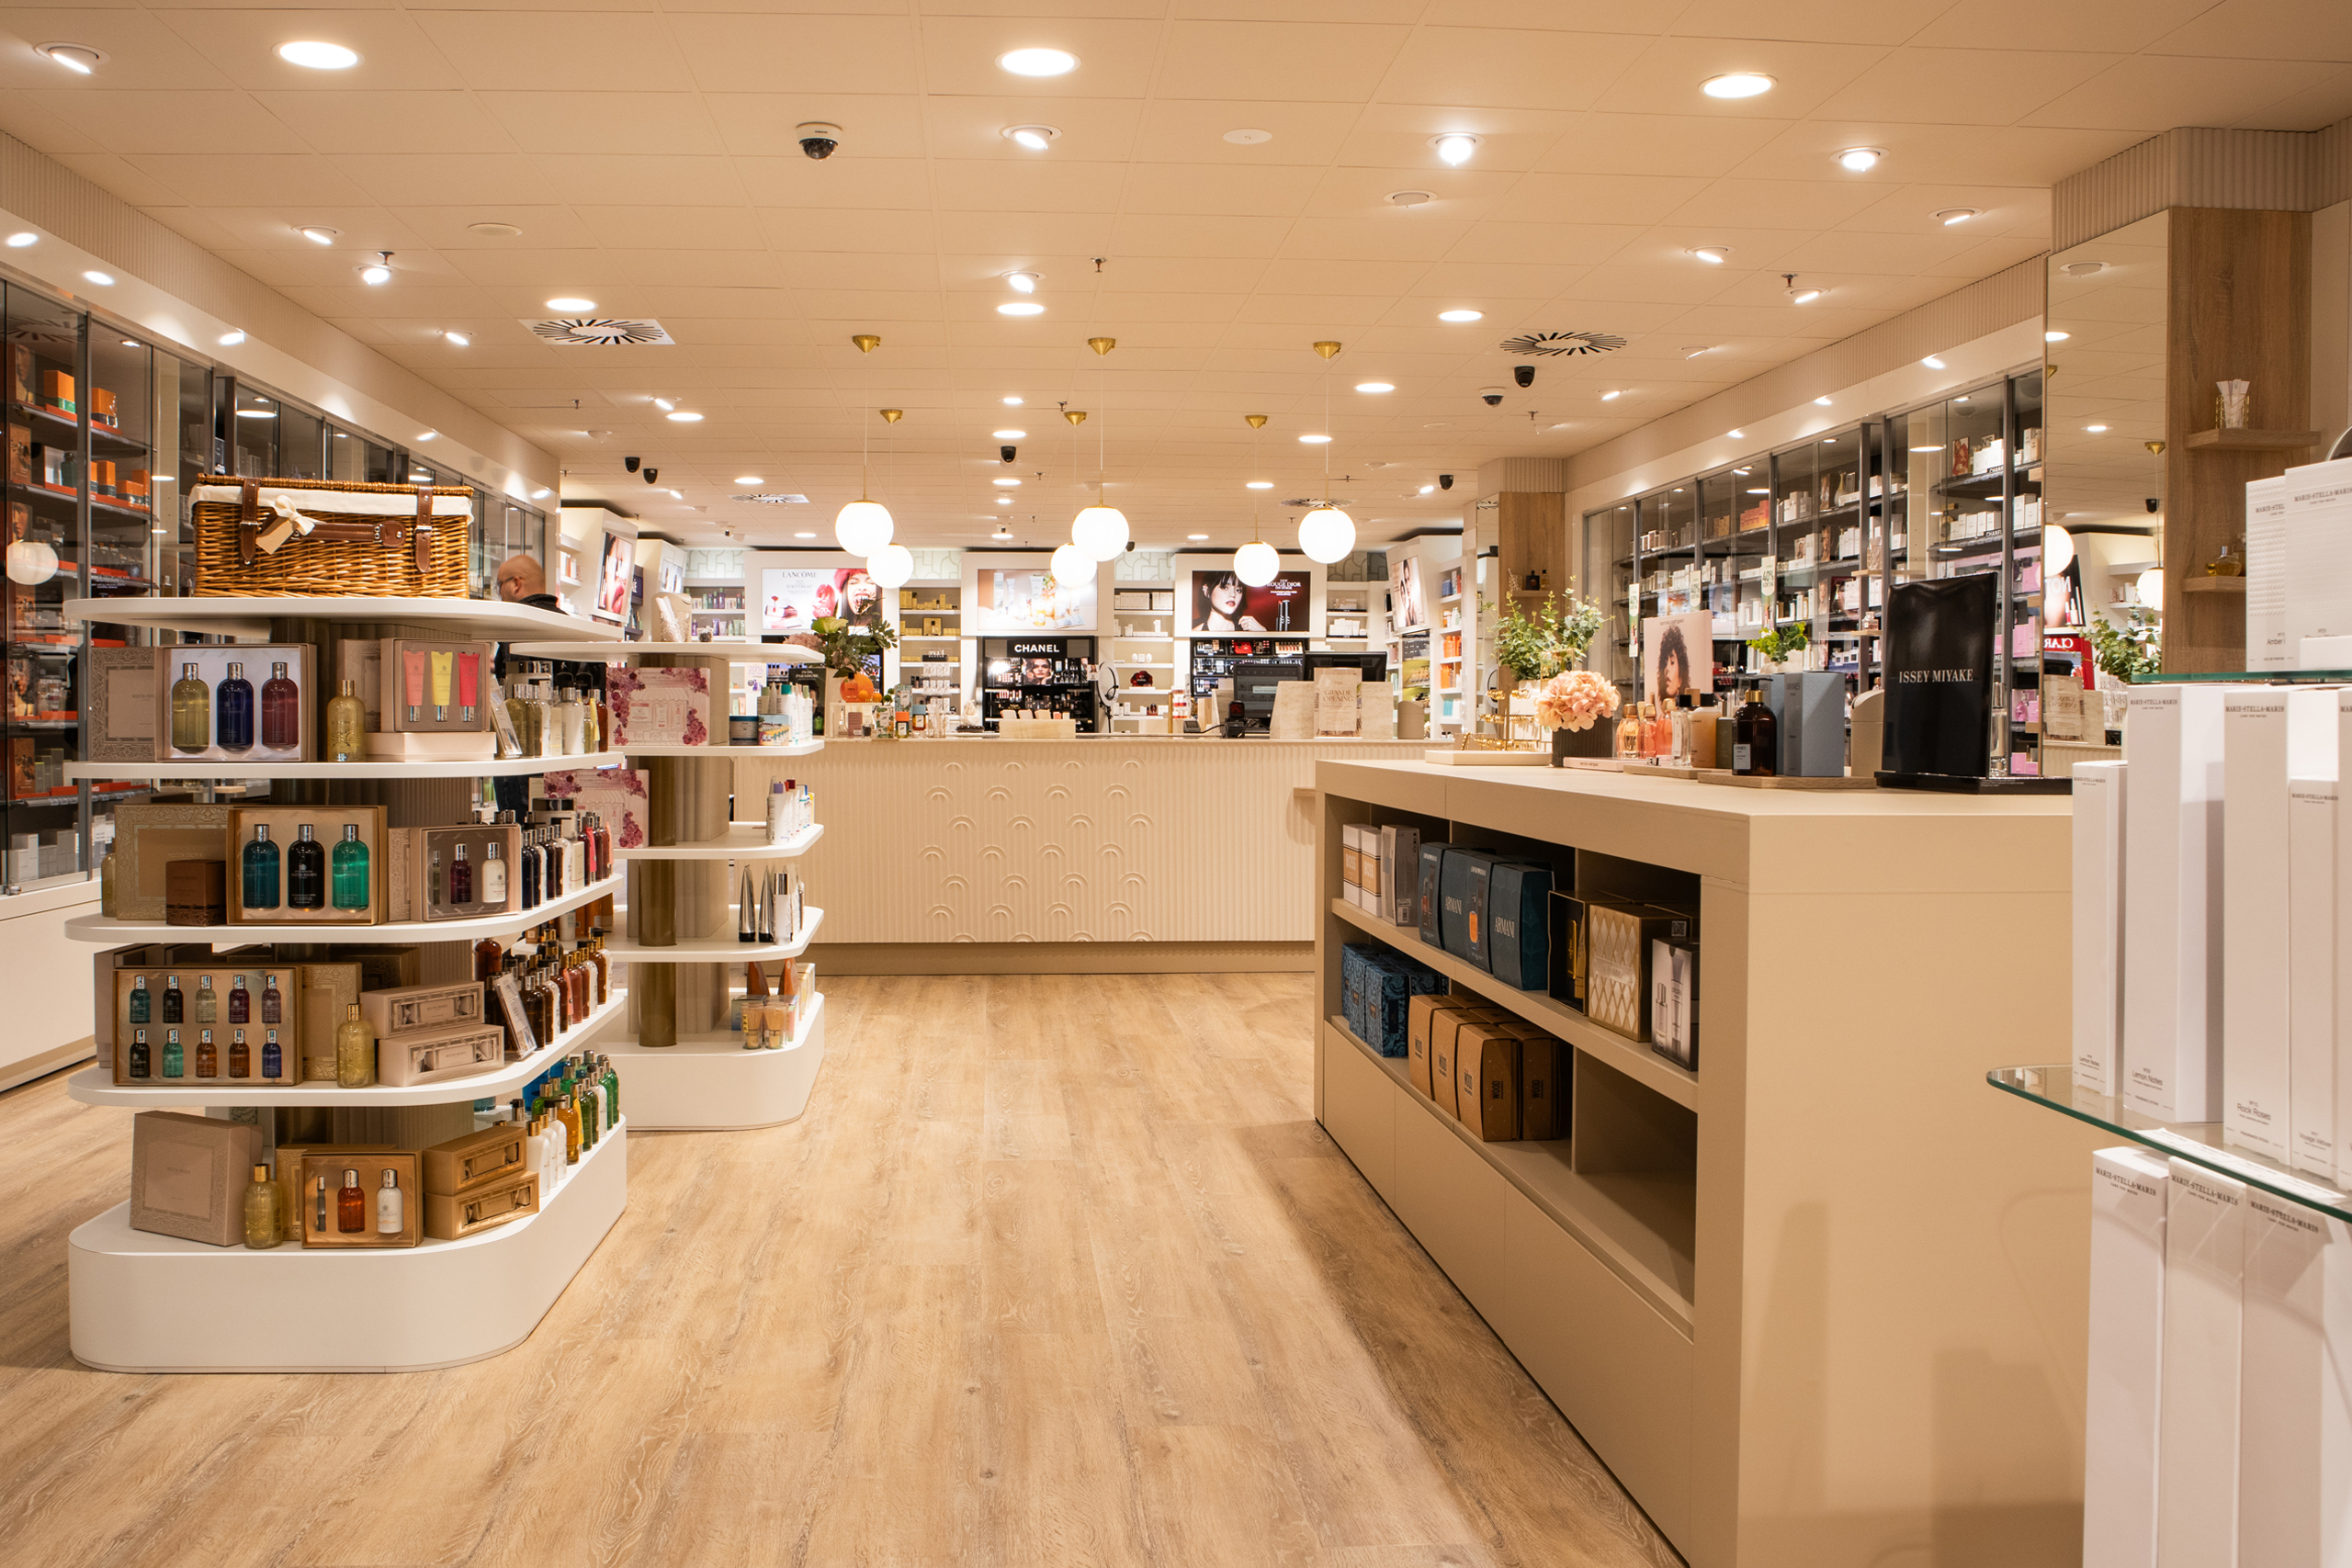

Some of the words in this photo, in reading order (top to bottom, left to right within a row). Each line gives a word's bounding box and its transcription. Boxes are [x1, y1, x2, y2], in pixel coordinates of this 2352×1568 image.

[1014, 644, 1060, 653] CHANEL
[1899, 671, 1929, 683] ISSEY
[1932, 669, 1973, 682] MIYAKE
[2291, 793, 2339, 801] MARIE-STELLA-MARIS
[1346, 853, 1356, 871] BOSS
[1364, 861, 1374, 879] BOSS
[1444, 896, 1462, 915] ARMANI
[1495, 916, 1515, 938] ARMANI
[1464, 1072, 1472, 1089] WOOD
[2132, 1069, 2148, 1080] Lemon
[2148, 1075, 2163, 1086] Notes
[1492, 1080, 1500, 1100] WOOD
[1532, 1079, 1541, 1099] WOOD
[2237, 1102, 2252, 1114] Rock
[2253, 1108, 2271, 1121] Roses
[2096, 1167, 2156, 1196] MARIE-STELLA-MARIS
[2171, 1174, 2238, 1206] MARIE-STELLA-MARIS
[2251, 1201, 2319, 1233] MARIE-STELLA-MARIS
